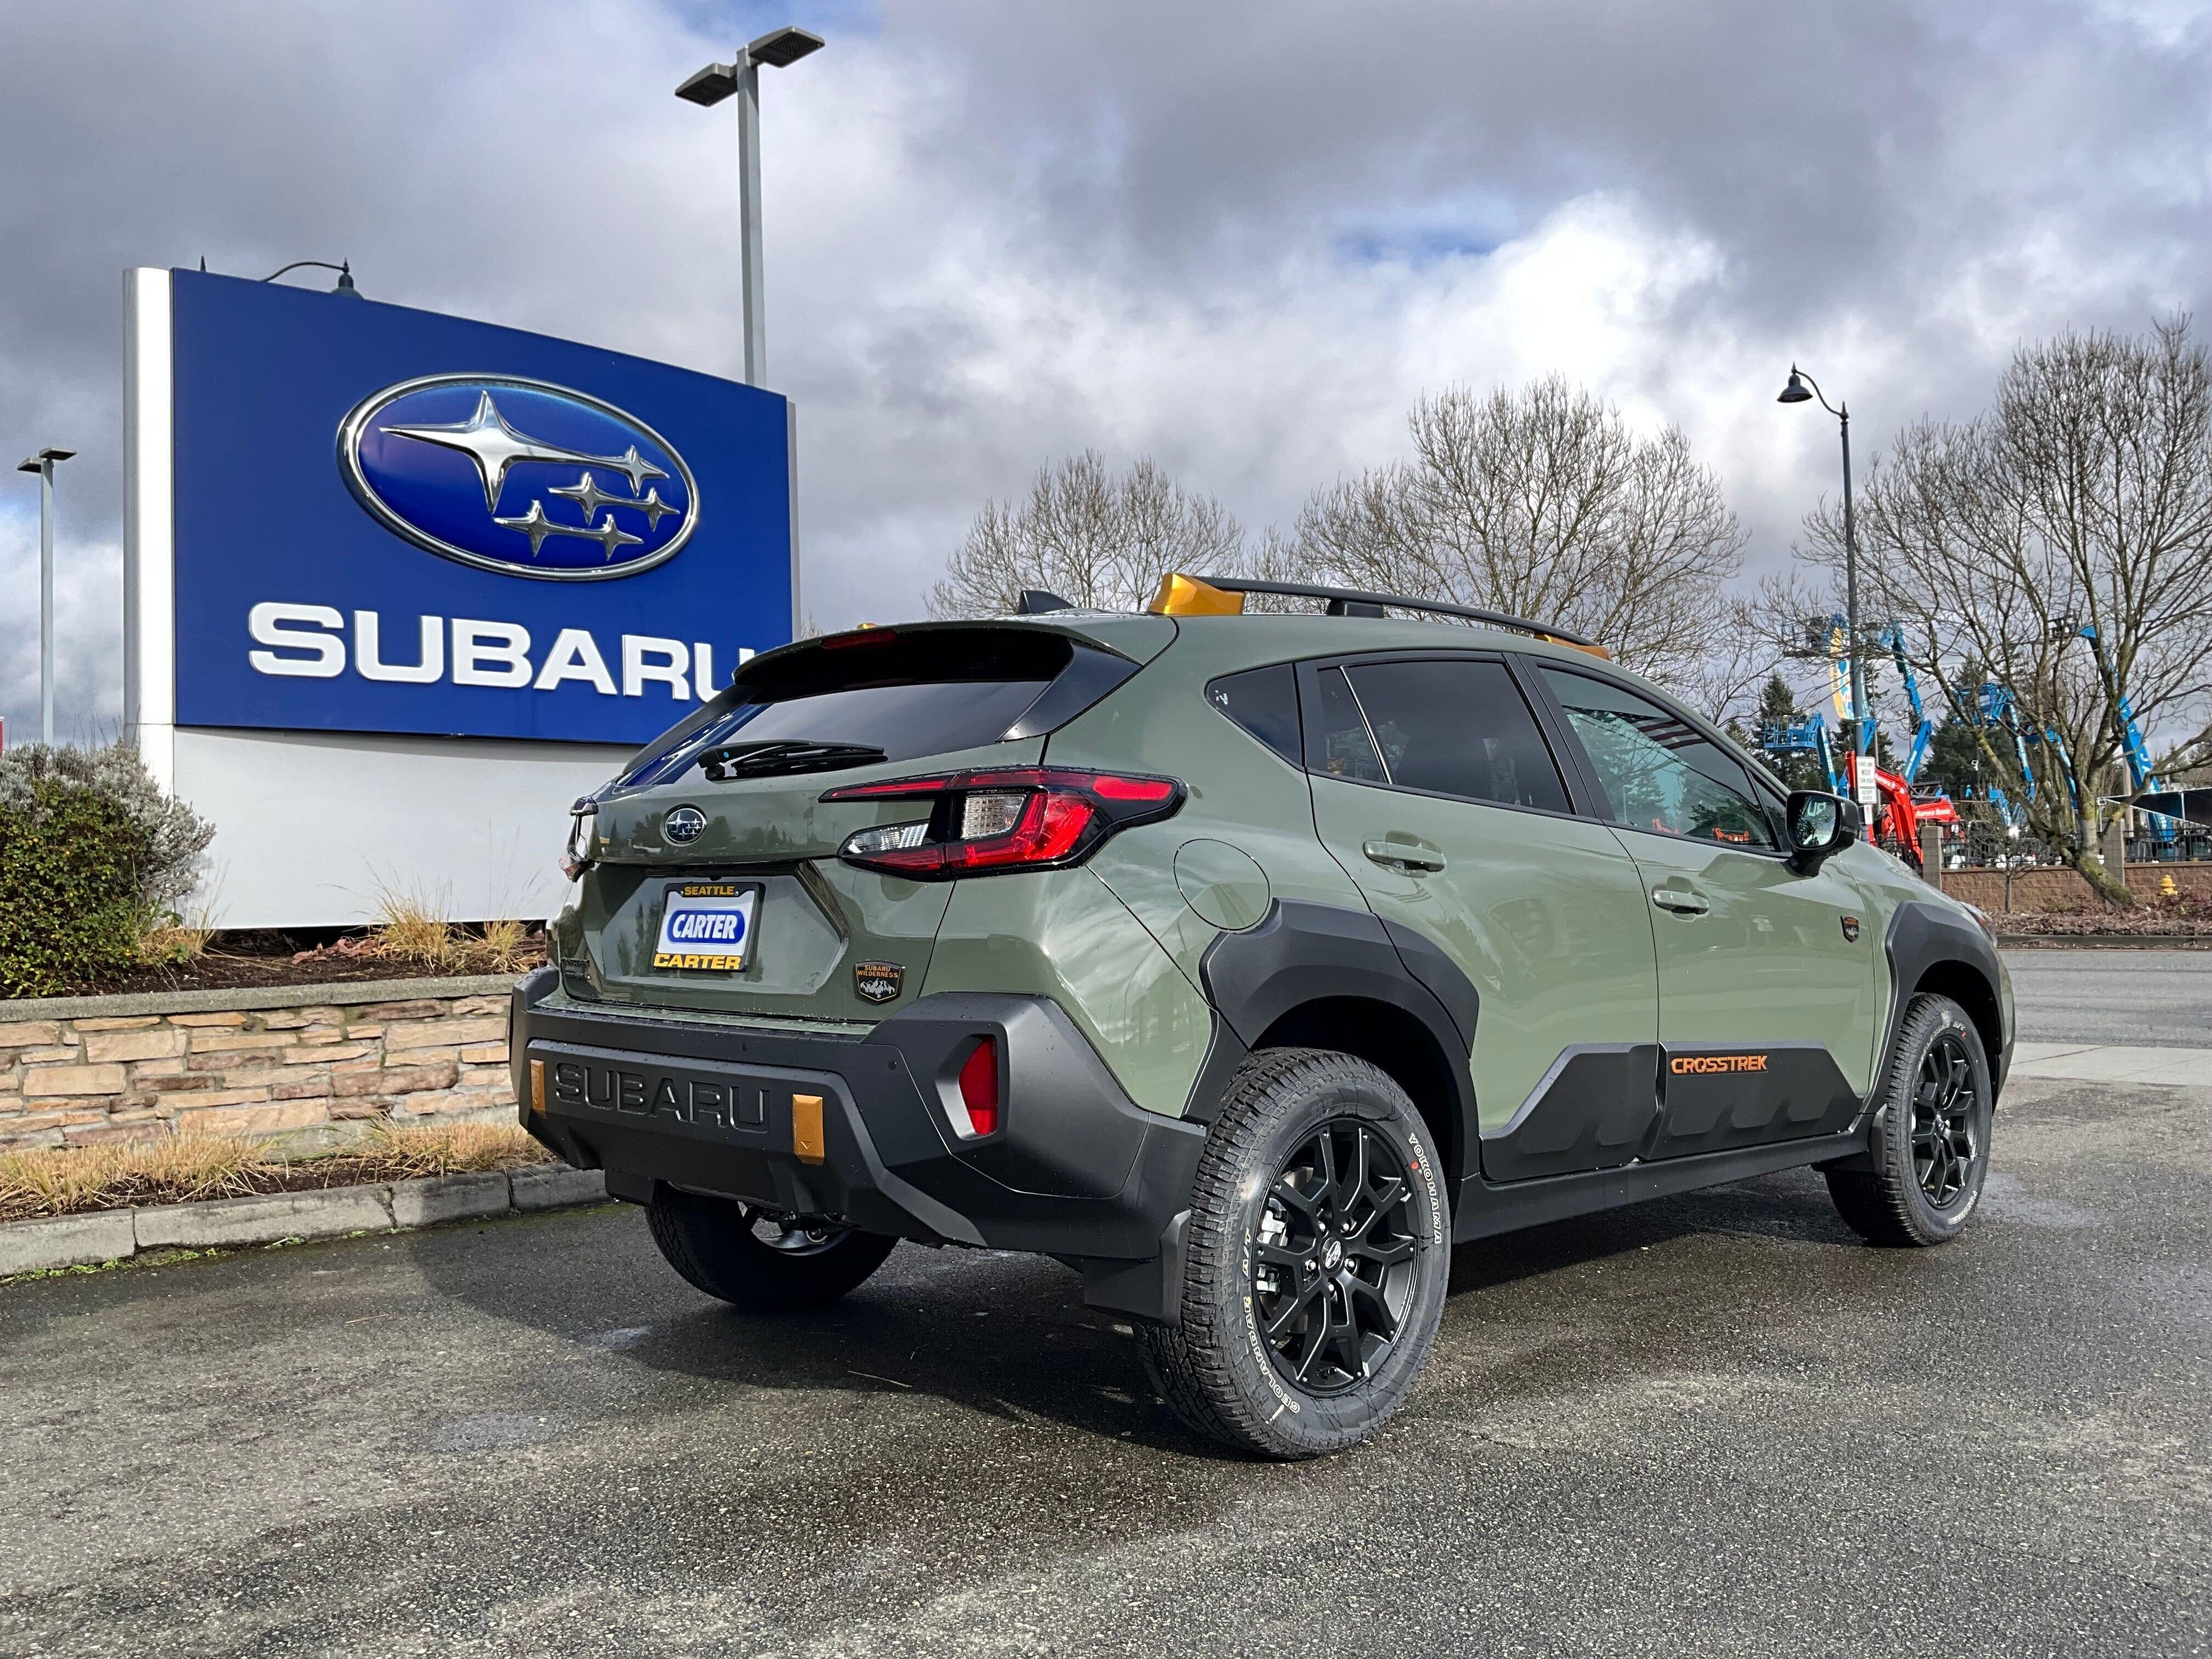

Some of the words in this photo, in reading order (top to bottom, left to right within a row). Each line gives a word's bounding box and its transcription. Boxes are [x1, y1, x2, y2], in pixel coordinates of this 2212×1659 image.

[249, 601, 755, 703] SUBARU
[684, 885, 735, 896] SEATTLE
[672, 913, 738, 939] CARTER
[653, 953, 742, 970] CARTER
[857, 970, 899, 978] WILDERNESS
[1671, 1055, 1768, 1074] CROSSTREK
[555, 1062, 770, 1135] SUBARU
[1408, 1132, 1442, 1244] YOKOHAMA
[1243, 1296, 1300, 1414] GEOLANDAR
